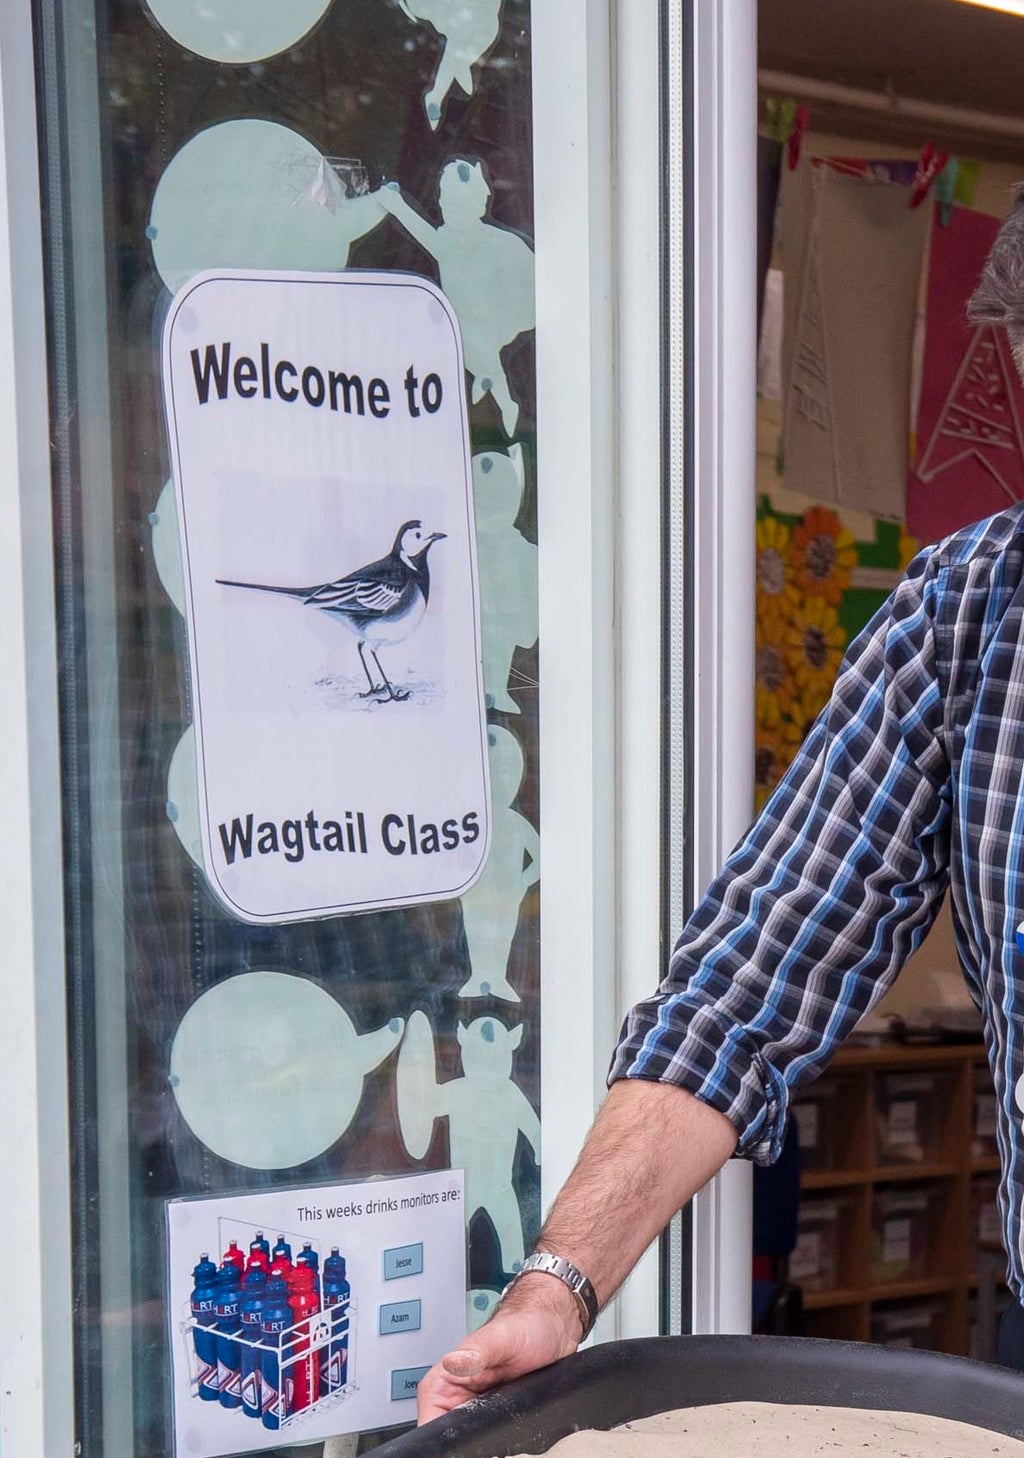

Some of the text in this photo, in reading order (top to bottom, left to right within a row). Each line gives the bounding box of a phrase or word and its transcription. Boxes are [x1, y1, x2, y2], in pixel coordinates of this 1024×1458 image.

[190, 341, 443, 419] Welcome to
[218, 806, 481, 866] Wagtail Class
[297, 1189, 461, 1222] This weeks drinks monitors are:
[395, 1258, 412, 1269] Jesse
[390, 1312, 409, 1324] Azam
